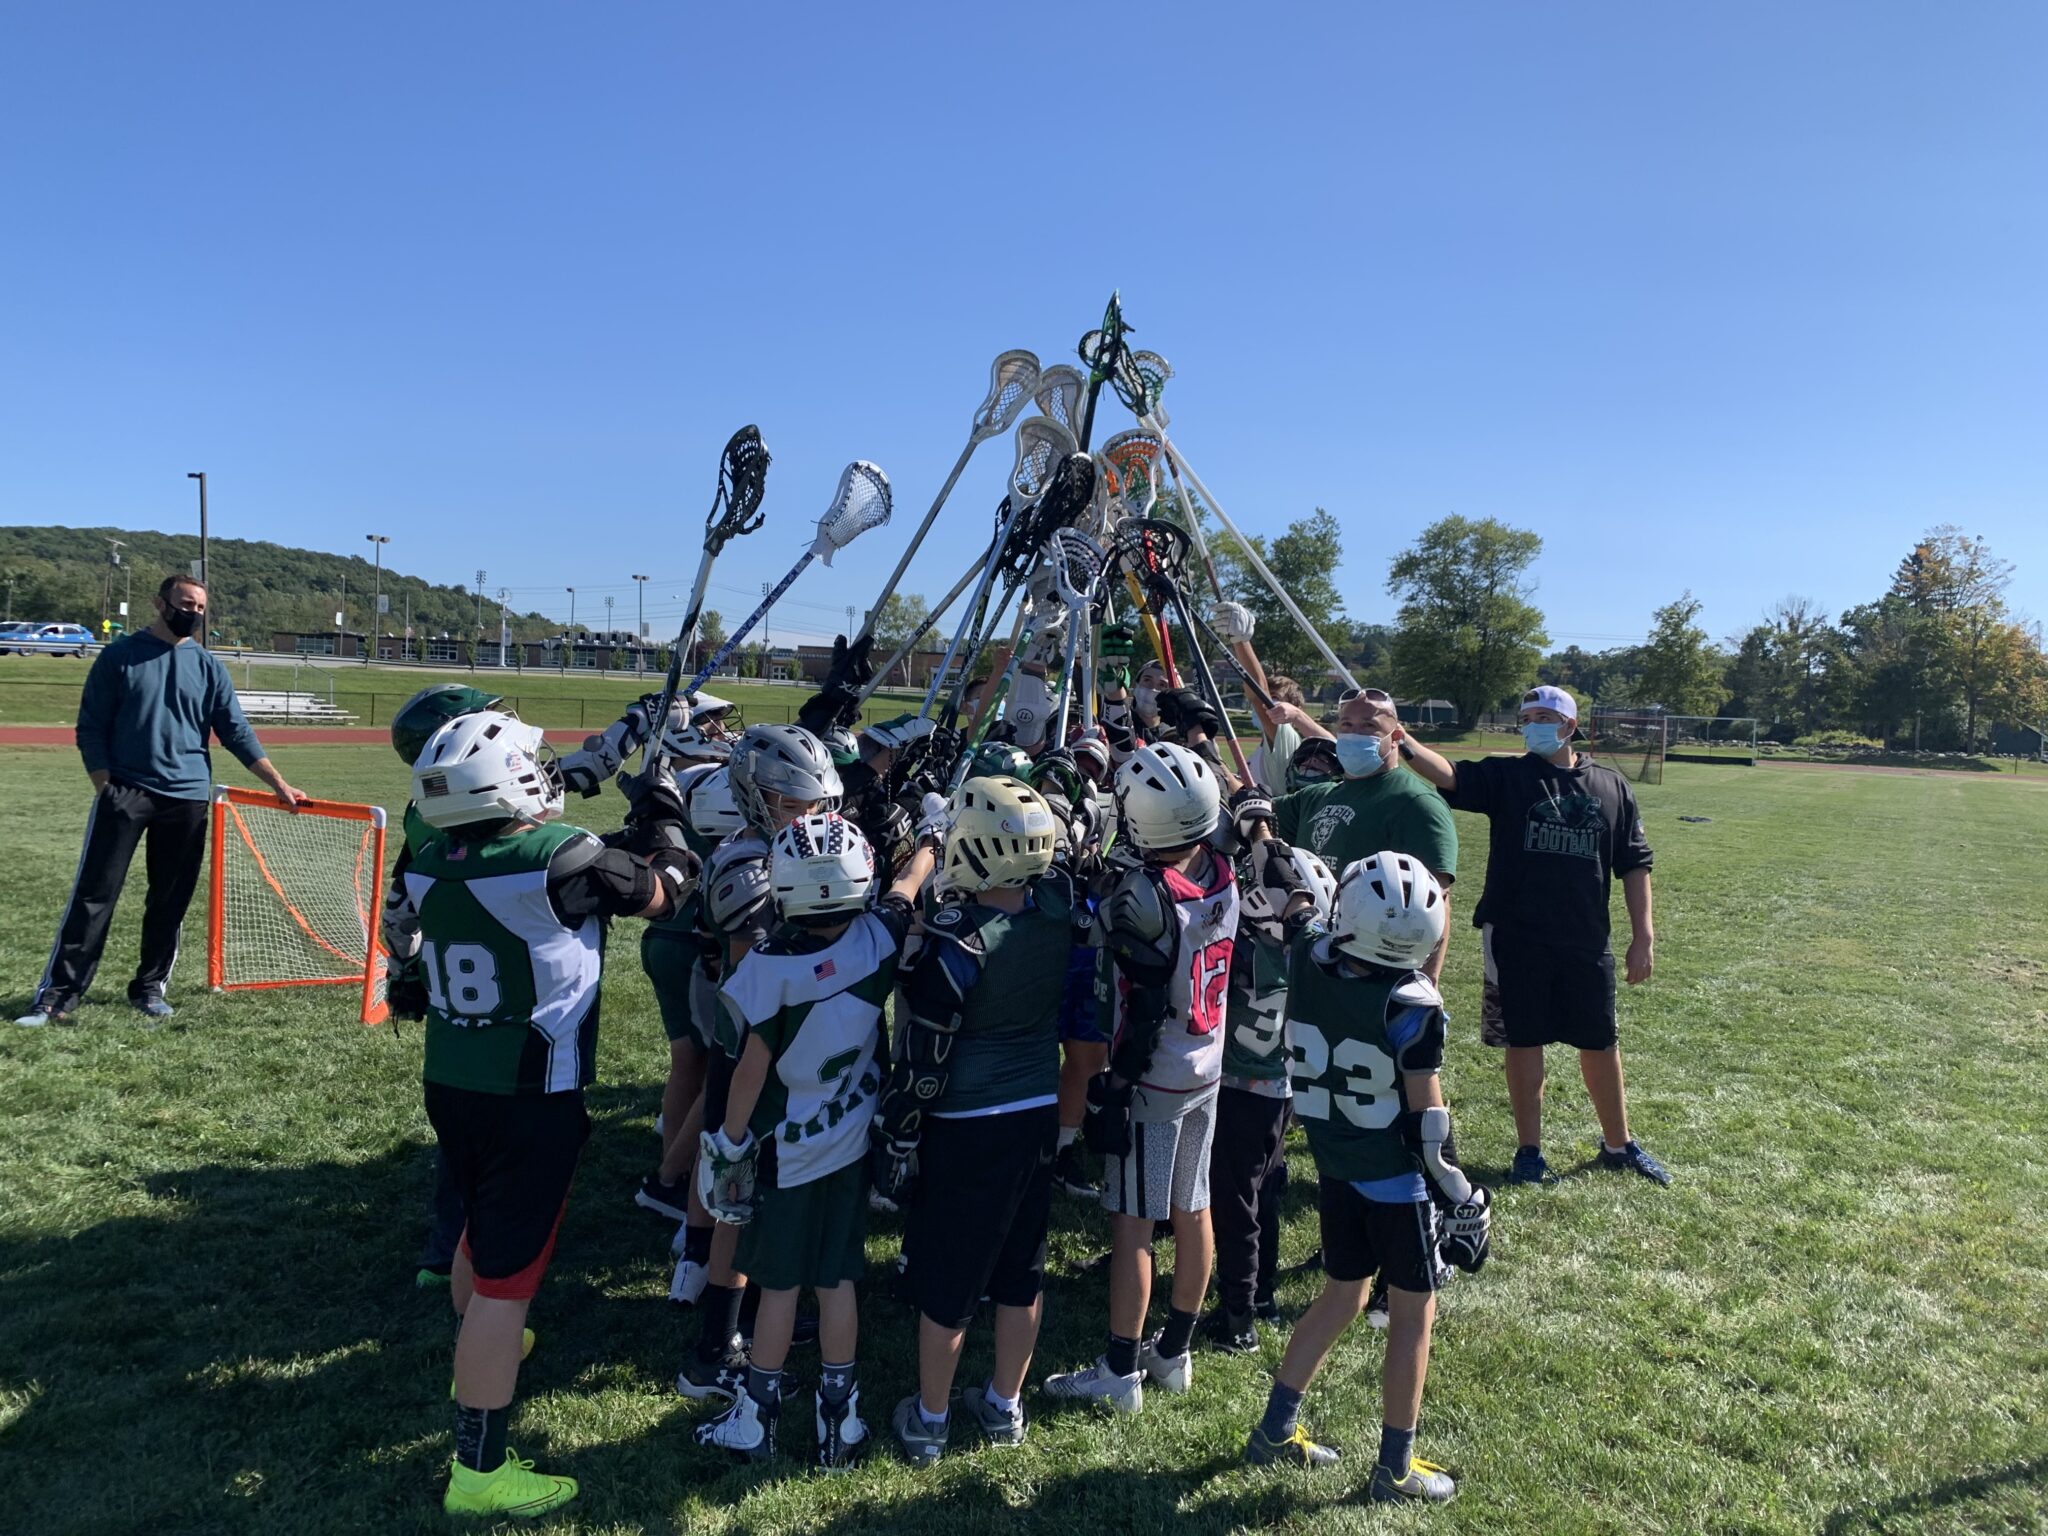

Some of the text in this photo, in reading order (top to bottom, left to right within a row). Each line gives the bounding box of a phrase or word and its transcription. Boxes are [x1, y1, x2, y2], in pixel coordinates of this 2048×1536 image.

[914, 618, 933, 638] STX
[881, 811, 912, 847] STX
[820, 885, 830, 899] 3
[421, 940, 502, 1014] 18
[1186, 937, 1234, 1036] 12
[1284, 1019, 1402, 1130] 23
